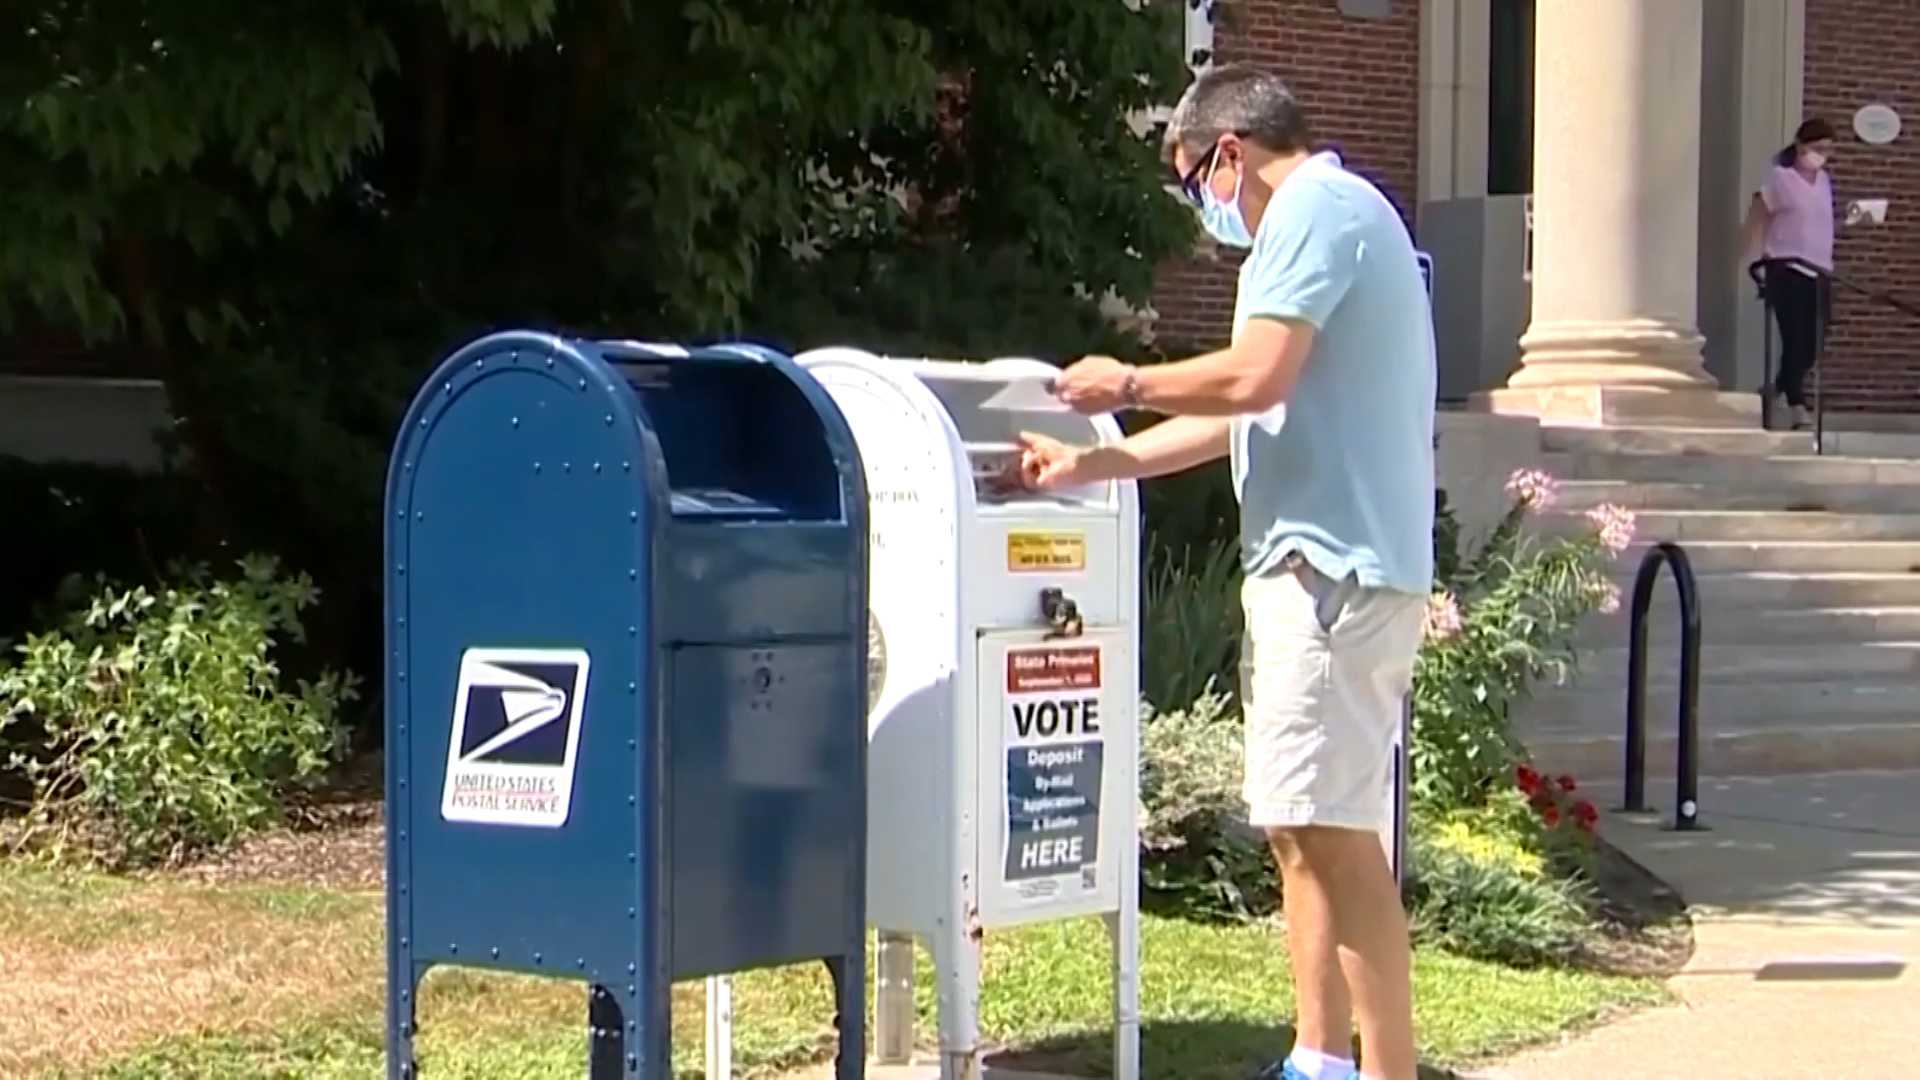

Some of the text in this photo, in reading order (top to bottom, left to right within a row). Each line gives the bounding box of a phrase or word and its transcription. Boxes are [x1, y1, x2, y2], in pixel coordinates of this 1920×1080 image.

[1012, 698, 1099, 738] VOTE
[1027, 745, 1084, 769] Deposit
[455, 773, 556, 795] UNITED STATES
[452, 789, 561, 814] POSTAL SERVICE
[1021, 836, 1083, 869] HERE
